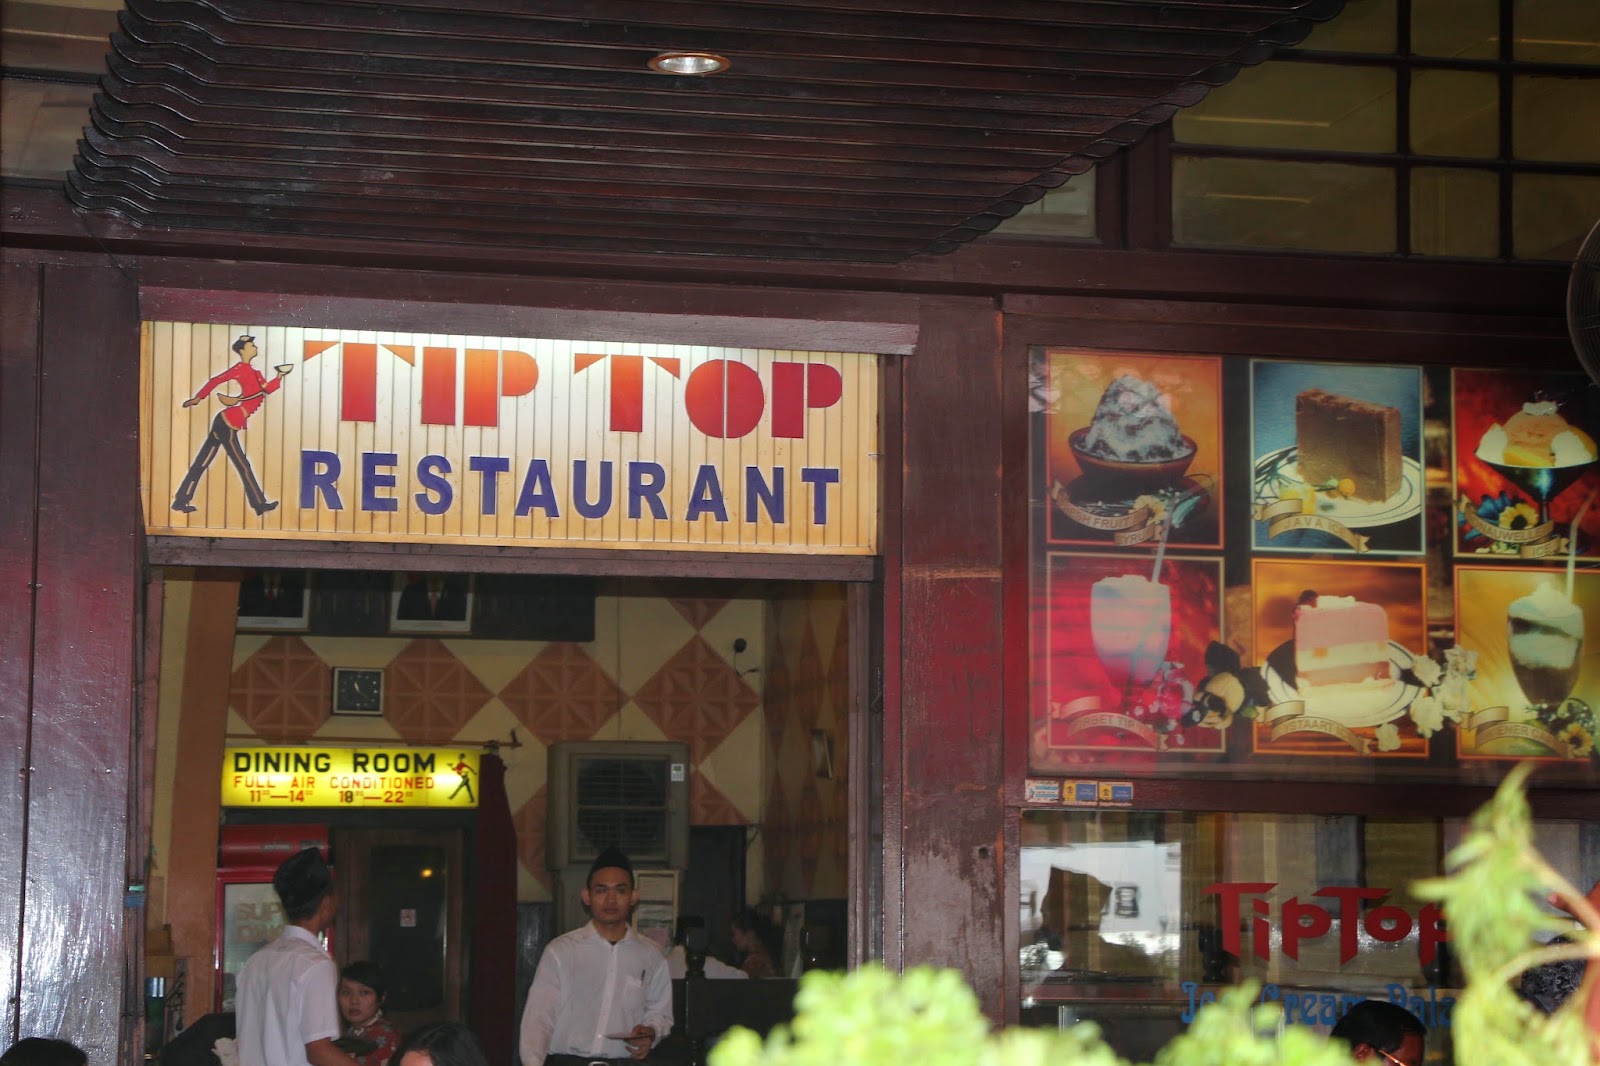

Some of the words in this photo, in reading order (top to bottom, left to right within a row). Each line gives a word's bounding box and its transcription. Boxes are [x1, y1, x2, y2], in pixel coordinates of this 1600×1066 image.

[303, 340, 539, 428] TIP
[574, 352, 843, 440] TOP
[300, 449, 839, 526] RESTAURANT
[233, 775, 276, 790] FULL
[290, 776, 316, 790] AIR
[330, 776, 435, 791] CONDITIONED
[234, 752, 331, 774] DINING
[352, 752, 435, 774] ROOM
